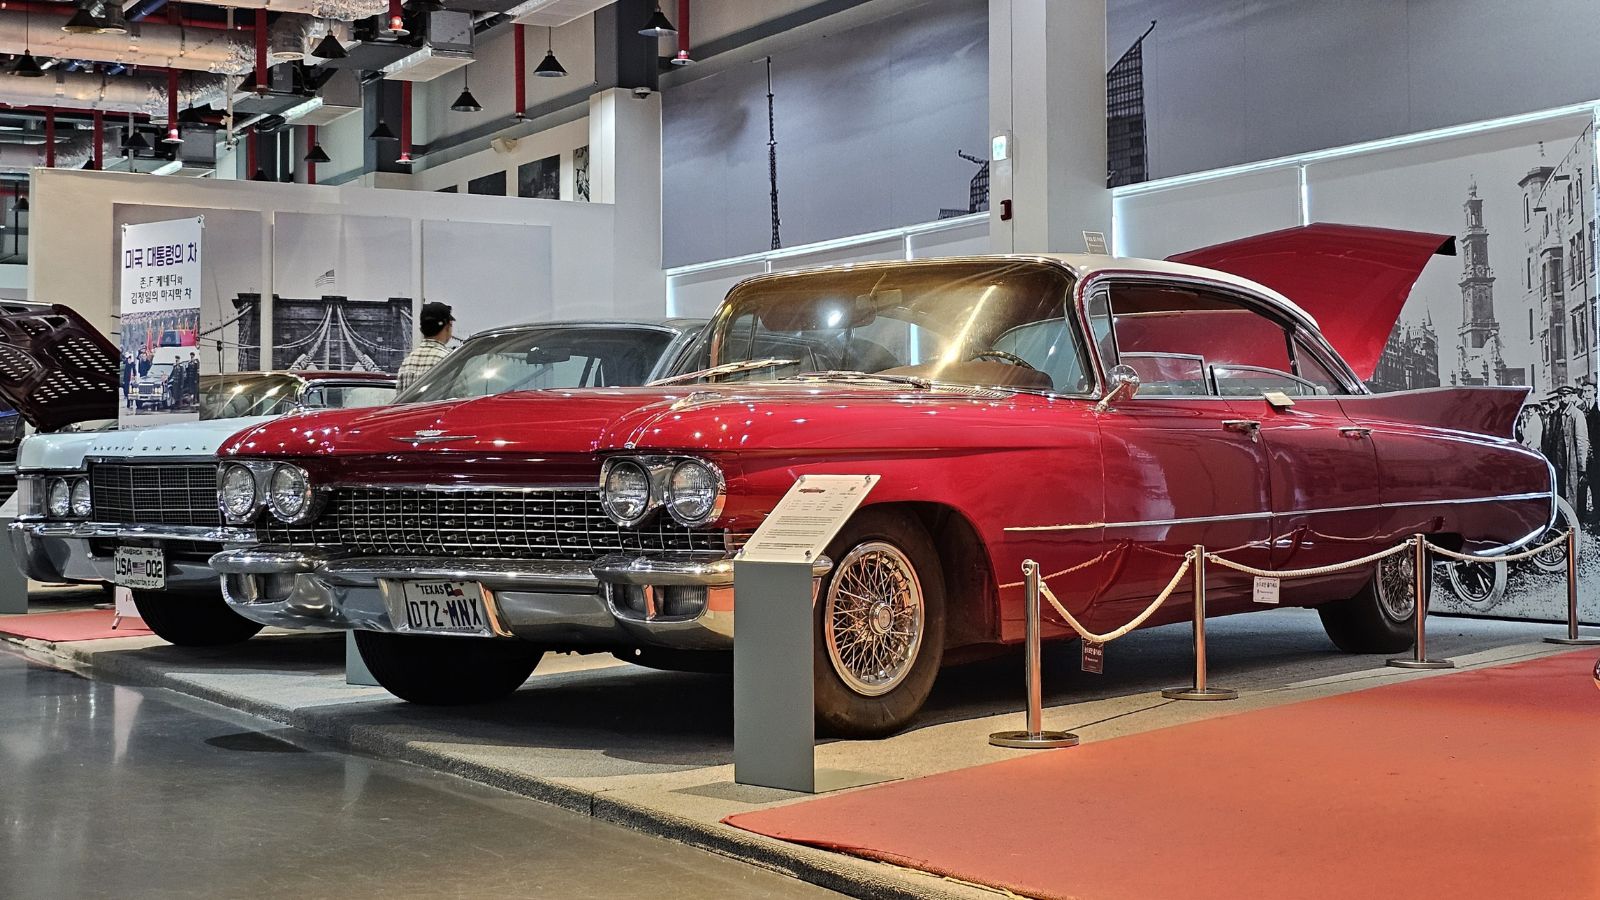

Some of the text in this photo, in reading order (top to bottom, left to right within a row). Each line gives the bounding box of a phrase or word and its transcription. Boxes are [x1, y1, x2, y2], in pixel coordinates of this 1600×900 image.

[125, 242, 198, 269] 미국 대통령의 차
[131, 287, 192, 304] 김정일의 마지막 차
[115, 557, 163, 578] USA 002
[420, 584, 445, 595] TEXAS
